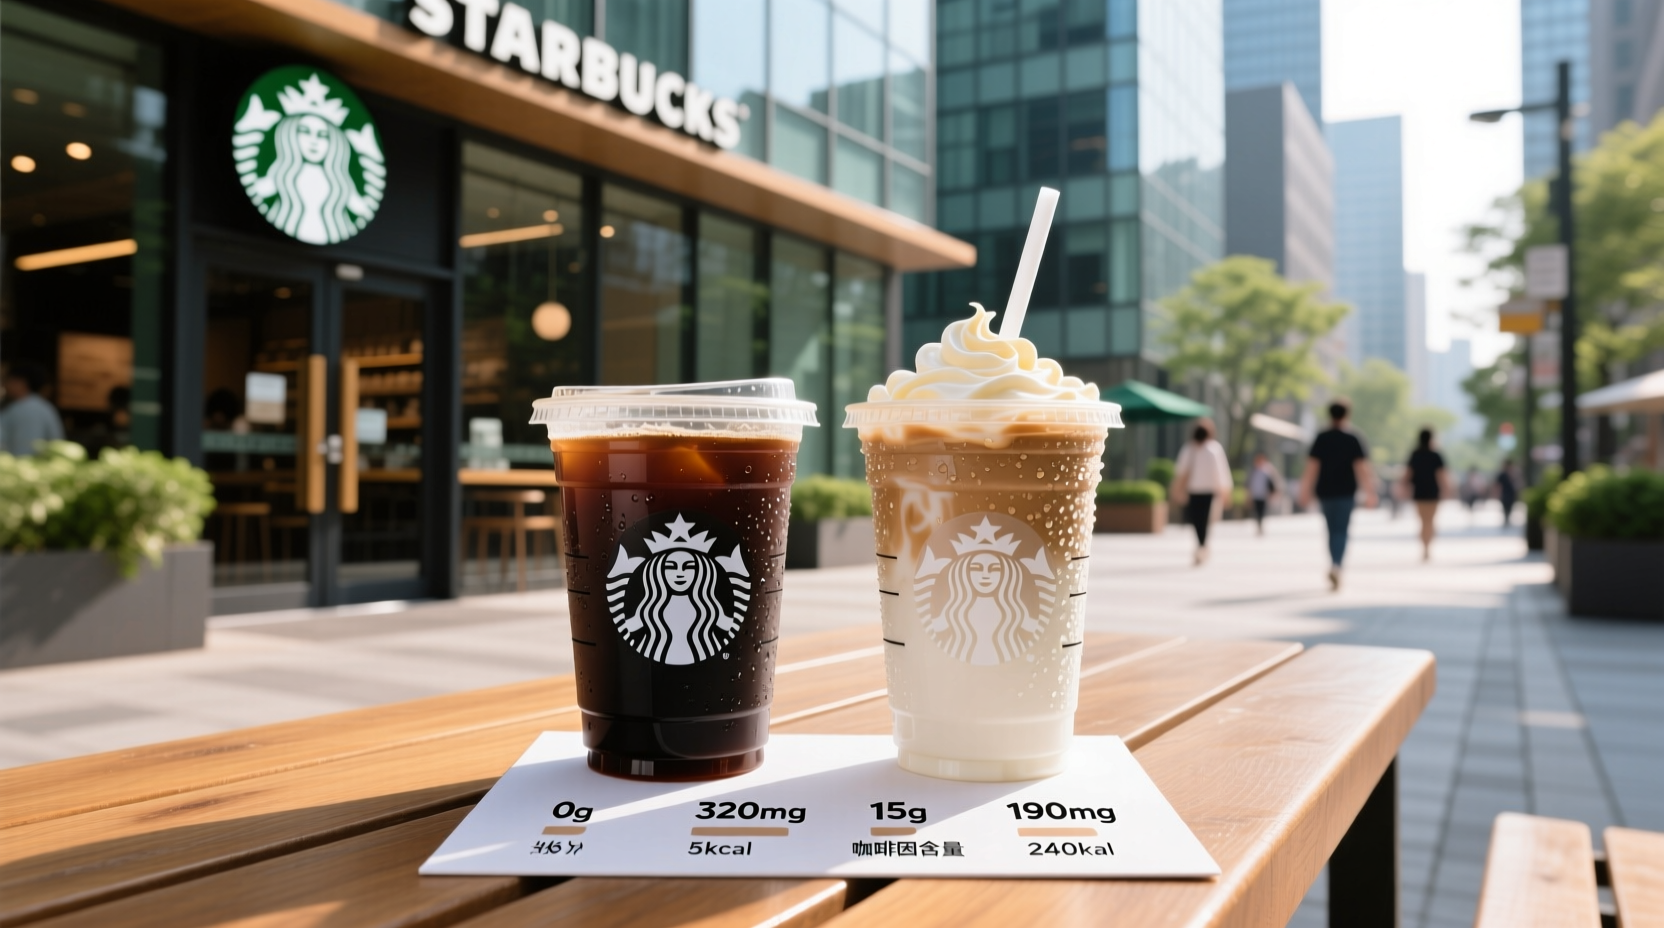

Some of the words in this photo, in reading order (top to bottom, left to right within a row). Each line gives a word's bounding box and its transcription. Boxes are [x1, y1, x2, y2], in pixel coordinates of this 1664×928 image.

[552, 801, 594, 823] 0g
[694, 801, 807, 824] 320mg
[869, 801, 927, 824] 15g
[1006, 802, 1117, 824] 190mg
[688, 841, 752, 856] 5kcal
[1028, 842, 1115, 856] 240kal
